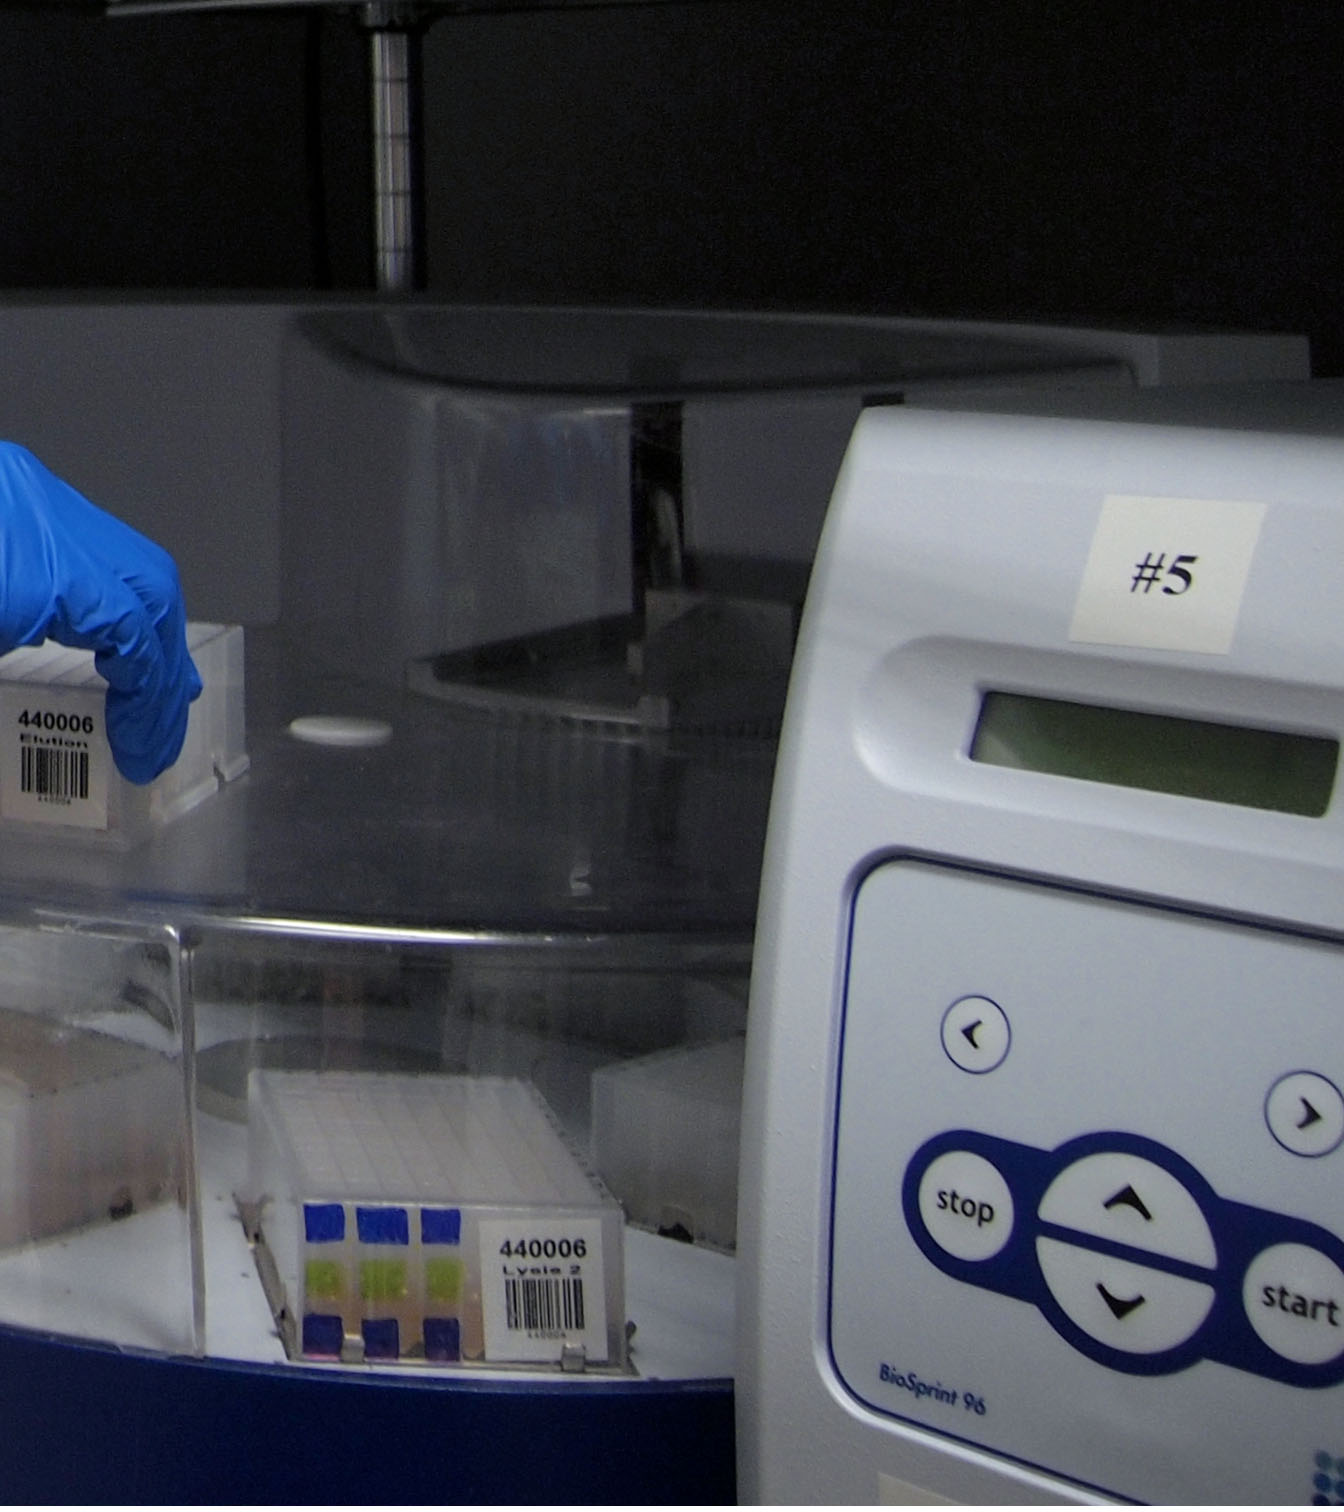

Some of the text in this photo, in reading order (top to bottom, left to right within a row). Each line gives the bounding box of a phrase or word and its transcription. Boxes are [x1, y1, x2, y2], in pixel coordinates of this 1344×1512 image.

[1130, 552, 1200, 596] #5
[18, 709, 94, 734] 440006
[936, 1185, 995, 1226] stop
[499, 1238, 587, 1259] 440006
[1261, 1283, 1340, 1328] start
[879, 1363, 987, 1416] BioSprint 96
